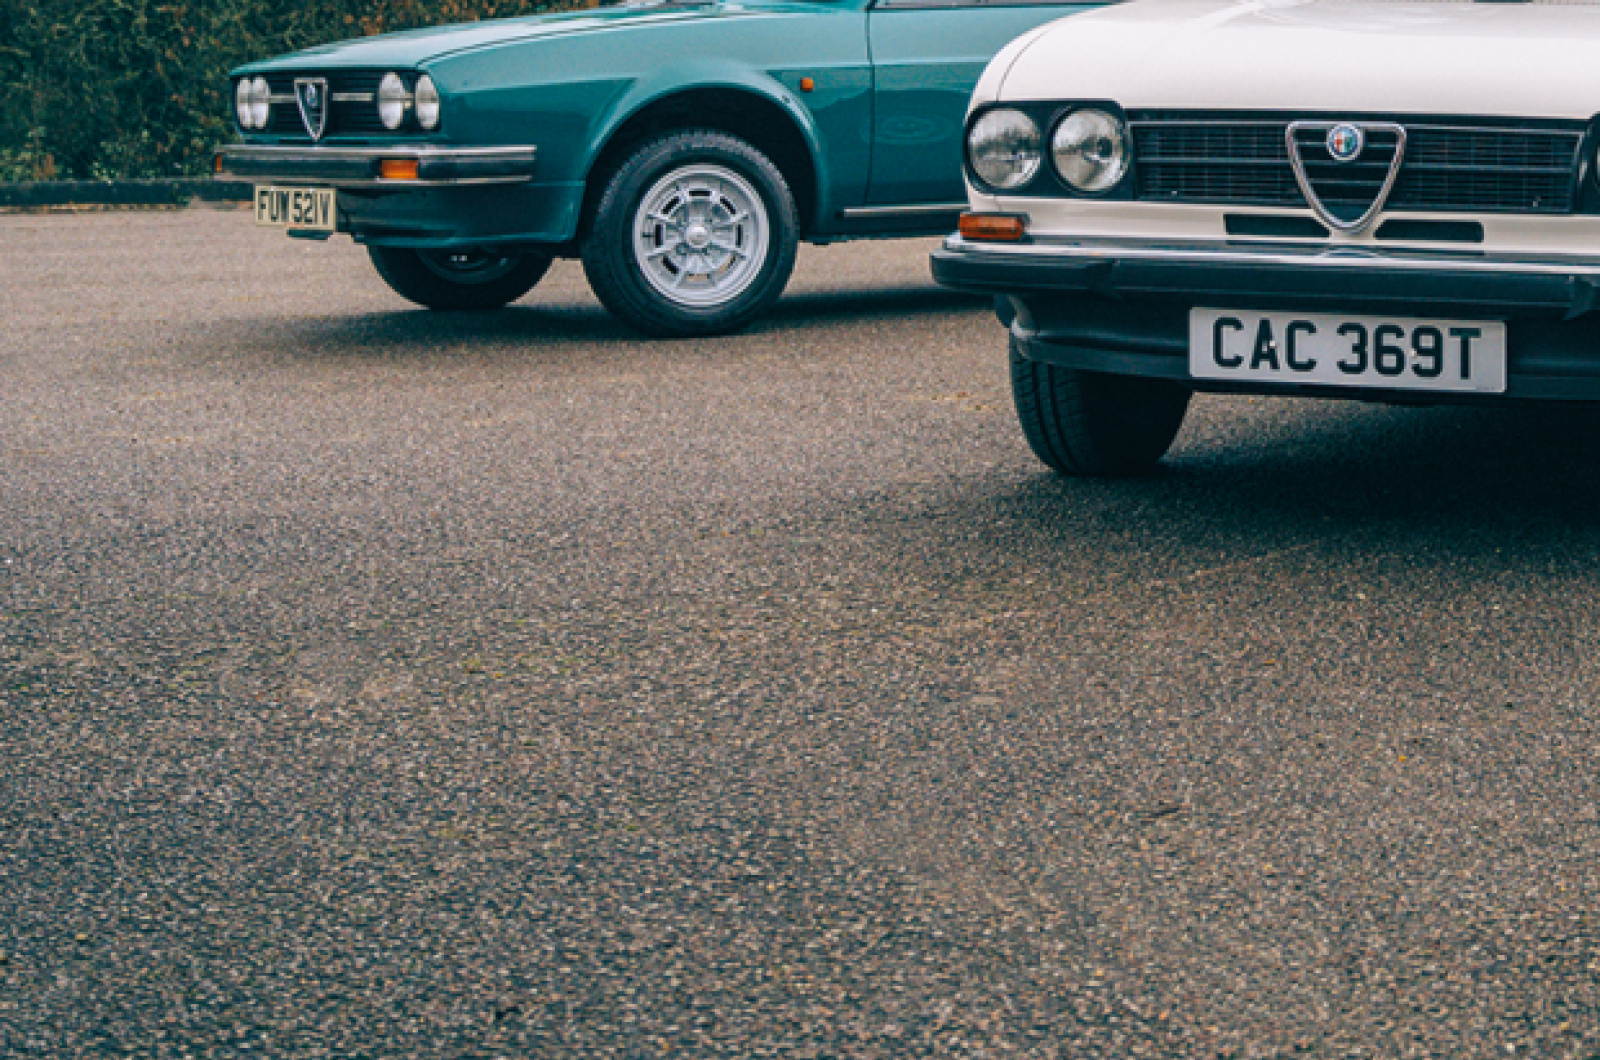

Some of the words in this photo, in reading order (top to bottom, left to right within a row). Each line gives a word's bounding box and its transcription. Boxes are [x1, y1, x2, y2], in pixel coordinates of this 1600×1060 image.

[292, 190, 332, 226] 521V
[1212, 316, 1318, 372] CAC
[1336, 321, 1482, 380] 369T
